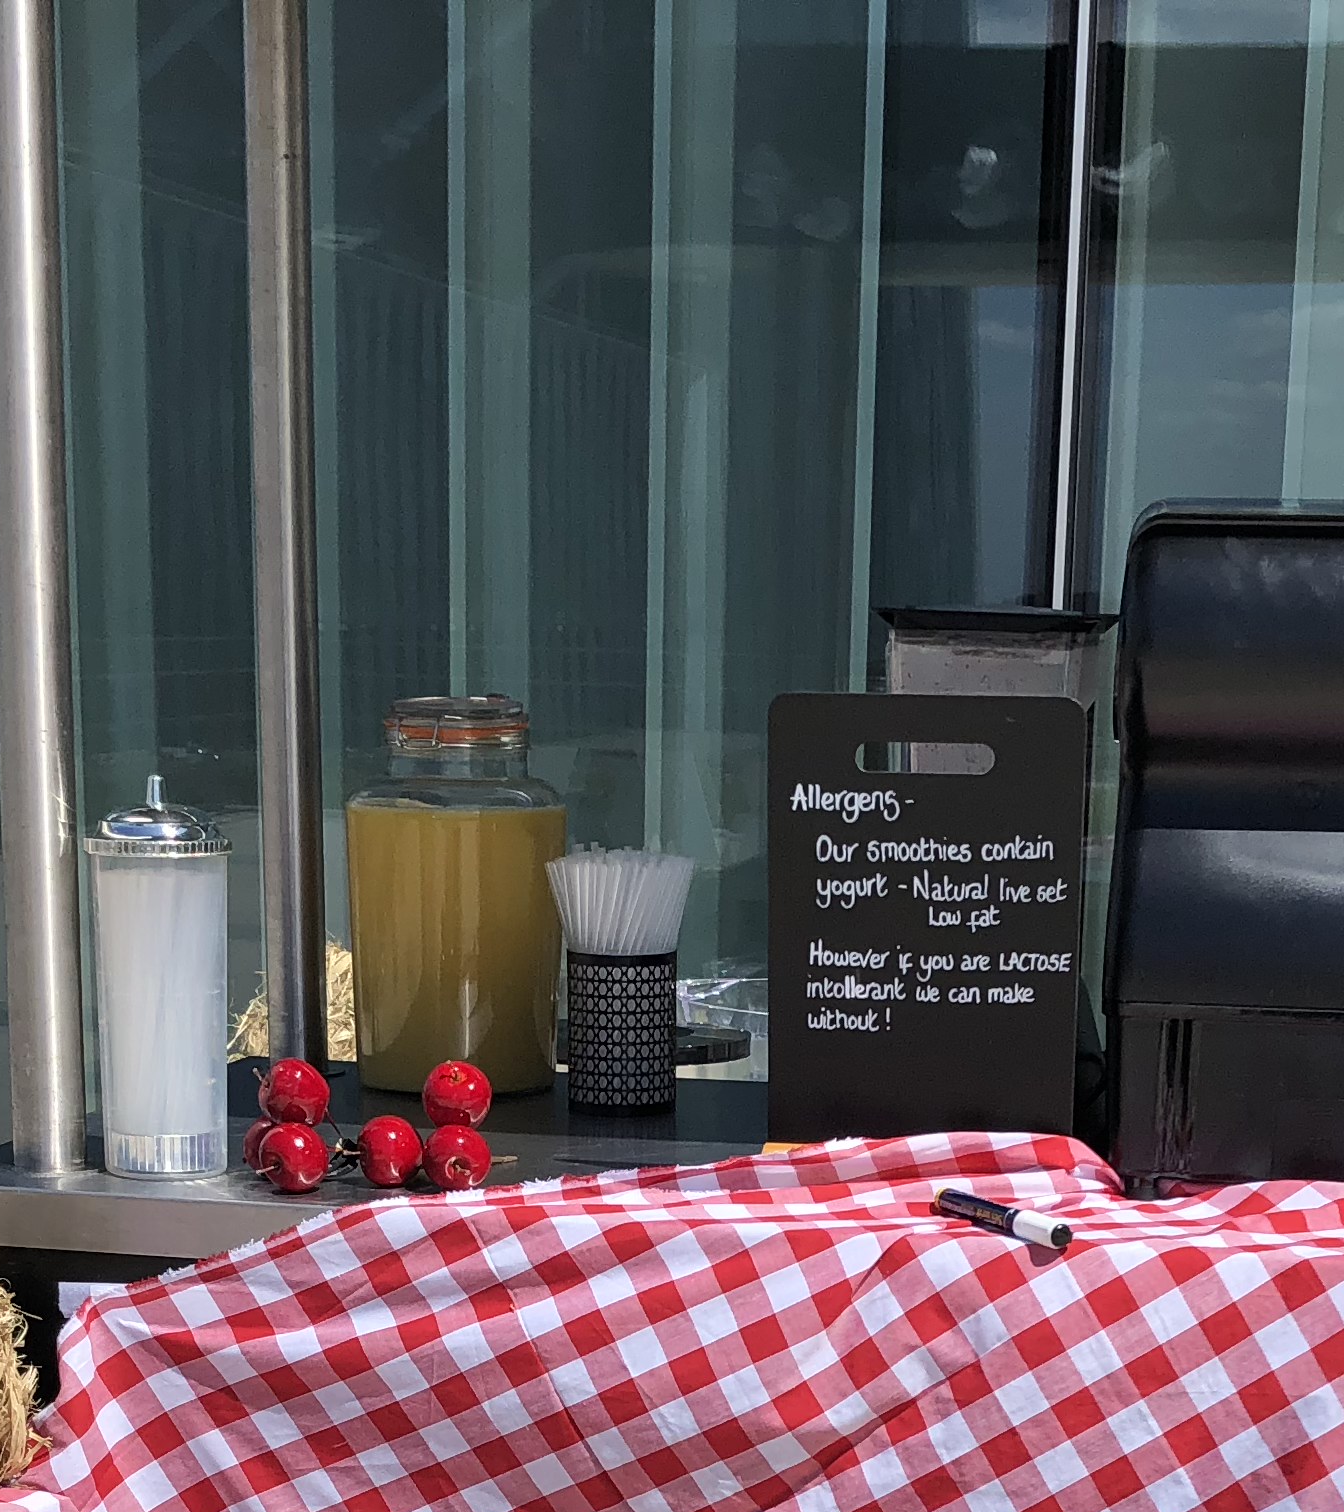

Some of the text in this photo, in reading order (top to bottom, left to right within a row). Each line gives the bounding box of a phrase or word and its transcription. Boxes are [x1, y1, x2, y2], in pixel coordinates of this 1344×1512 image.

[815, 834, 1054, 863] Our smoothies contain
[815, 873, 889, 910] yogurt
[999, 877, 1032, 903] live
[1036, 877, 1068, 903] set
[928, 904, 1001, 933] Low fat
[809, 938, 1073, 983] However if you are LACTOSE
[915, 984, 941, 1003] we
[948, 986, 981, 1004] can
[987, 982, 1035, 1004] make
